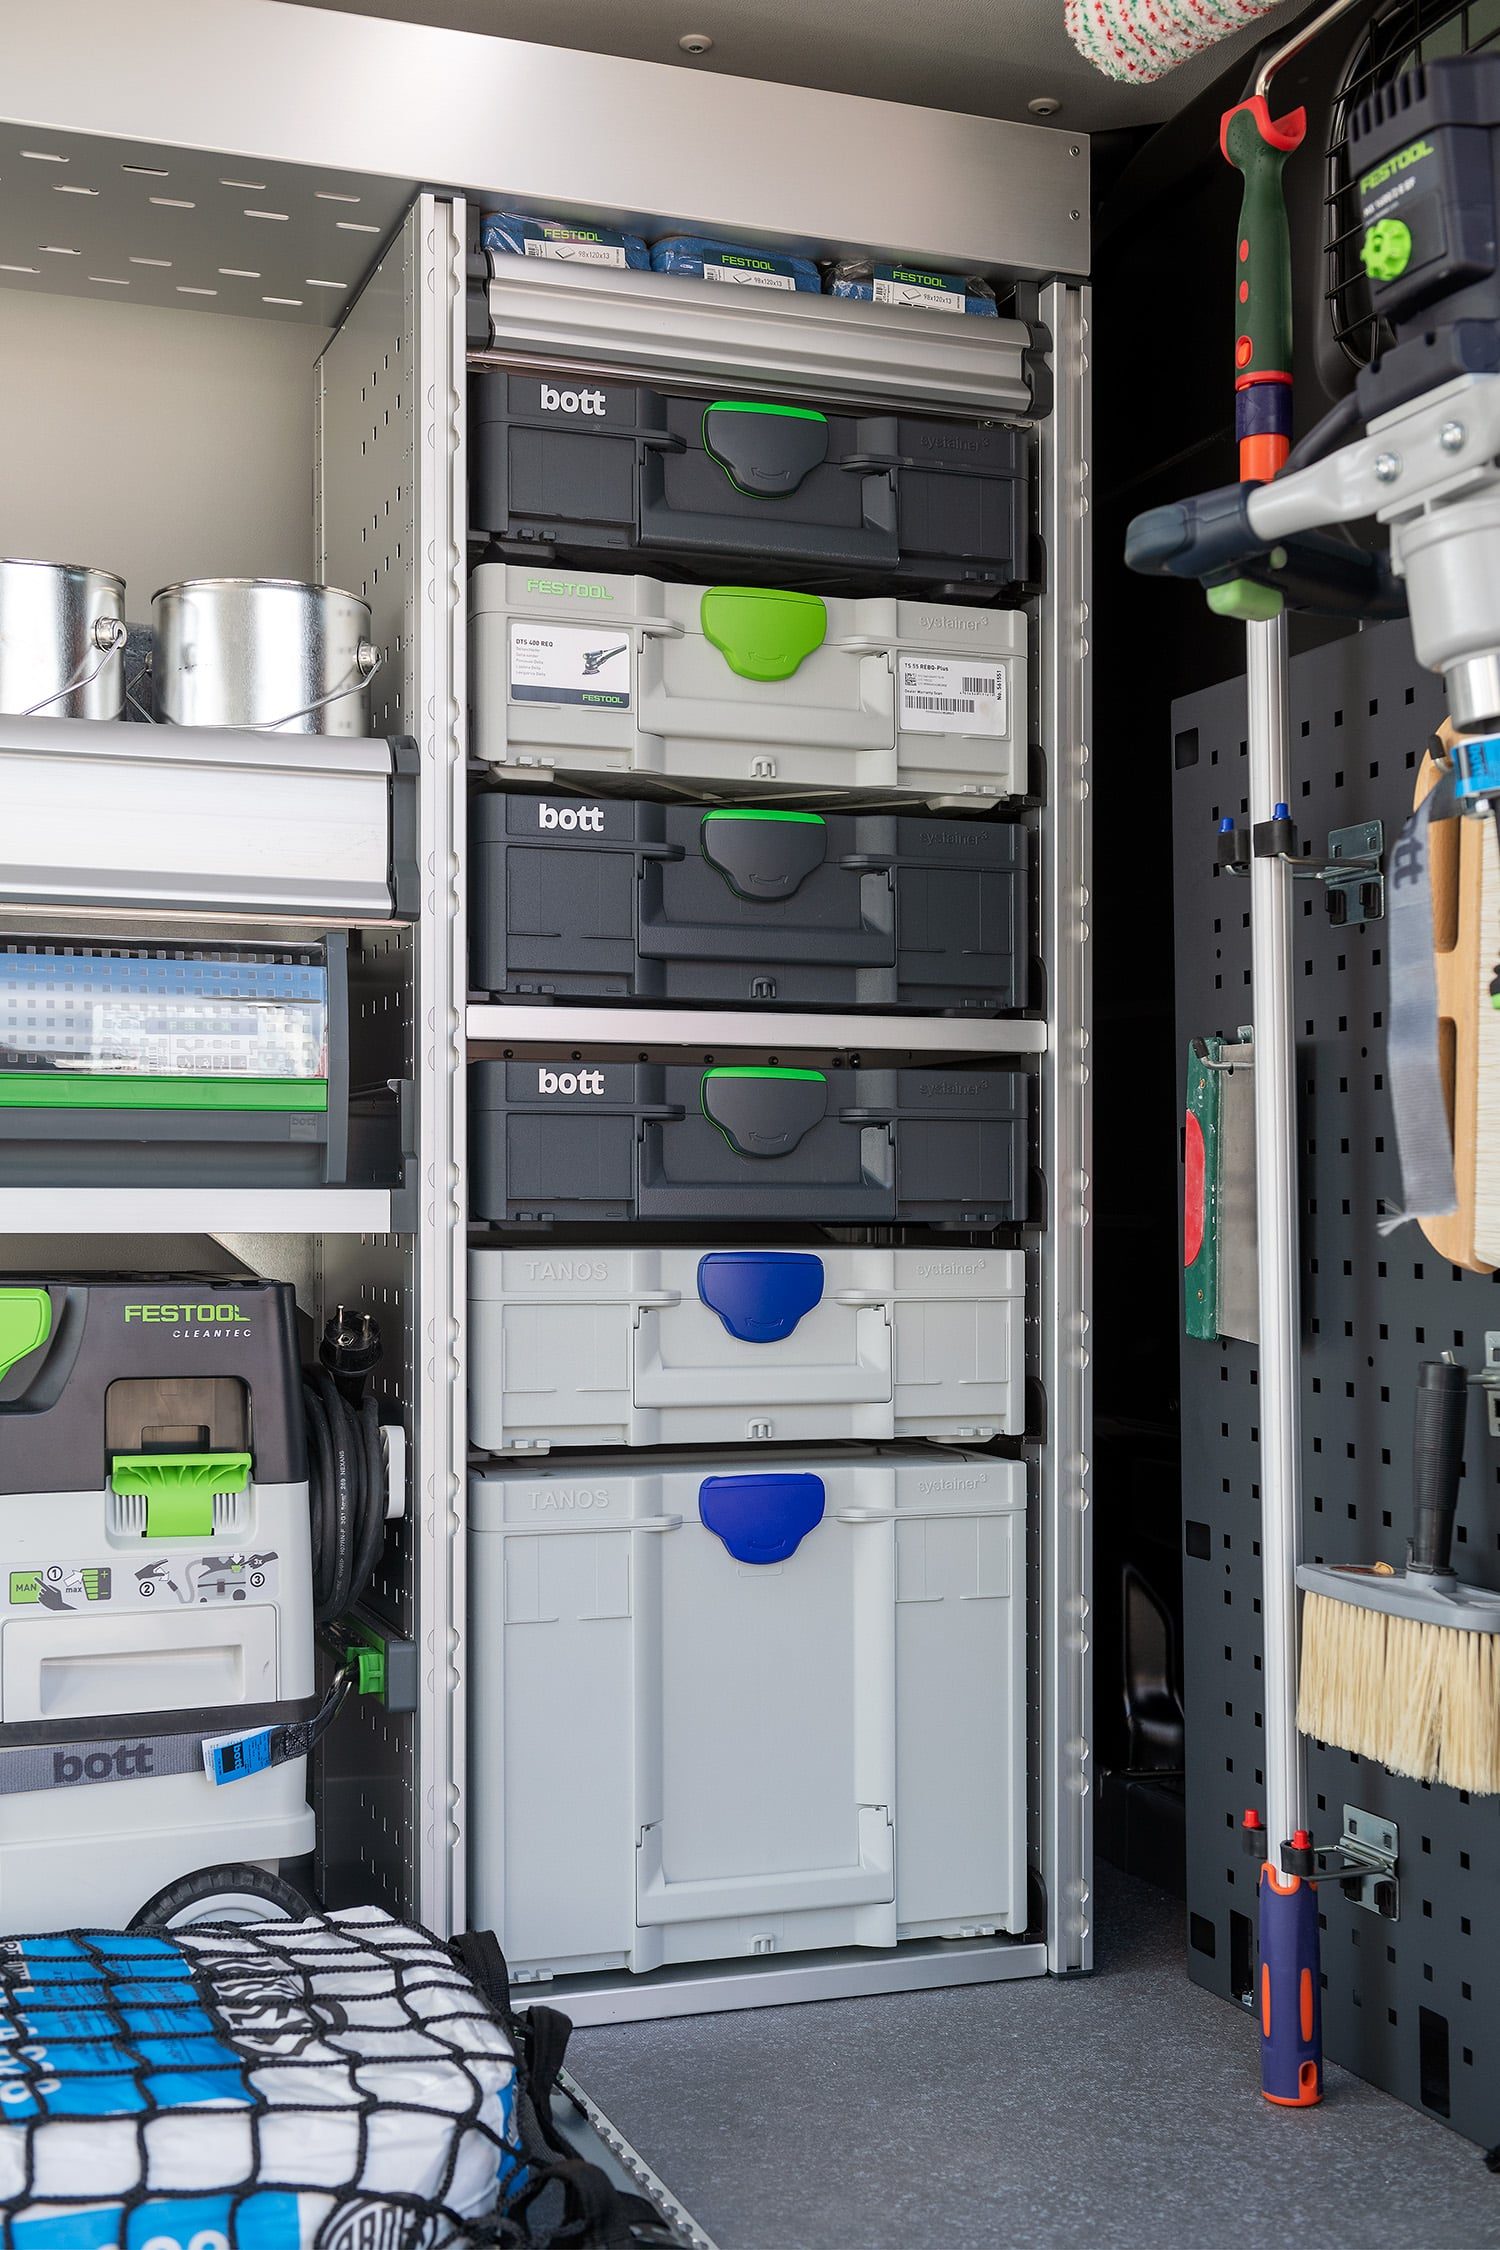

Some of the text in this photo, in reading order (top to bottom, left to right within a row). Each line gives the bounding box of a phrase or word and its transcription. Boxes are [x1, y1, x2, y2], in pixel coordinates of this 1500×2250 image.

[1361, 141, 1434, 195] FESTOOL
[544, 228, 603, 242] FESTOOL
[578, 250, 610, 260] 98x120x13
[721, 255, 775, 271] FESTOOL
[893, 271, 947, 288] FESTOOL
[540, 385, 606, 417] bott
[527, 579, 615, 600] FESTOOL
[582, 694, 623, 704] FESTOOL
[538, 804, 605, 832] bott
[538, 1069, 605, 1095] bott
[525, 1261, 608, 1281] TANOS
[124, 1304, 252, 1322] FESTOOL
[172, 1329, 252, 1338] CLEANTEC
[527, 1489, 609, 1510] TANOS
[15, 1584, 37, 1593] MAN
[65, 1586, 82, 1594] max
[53, 1743, 154, 1783] bott
